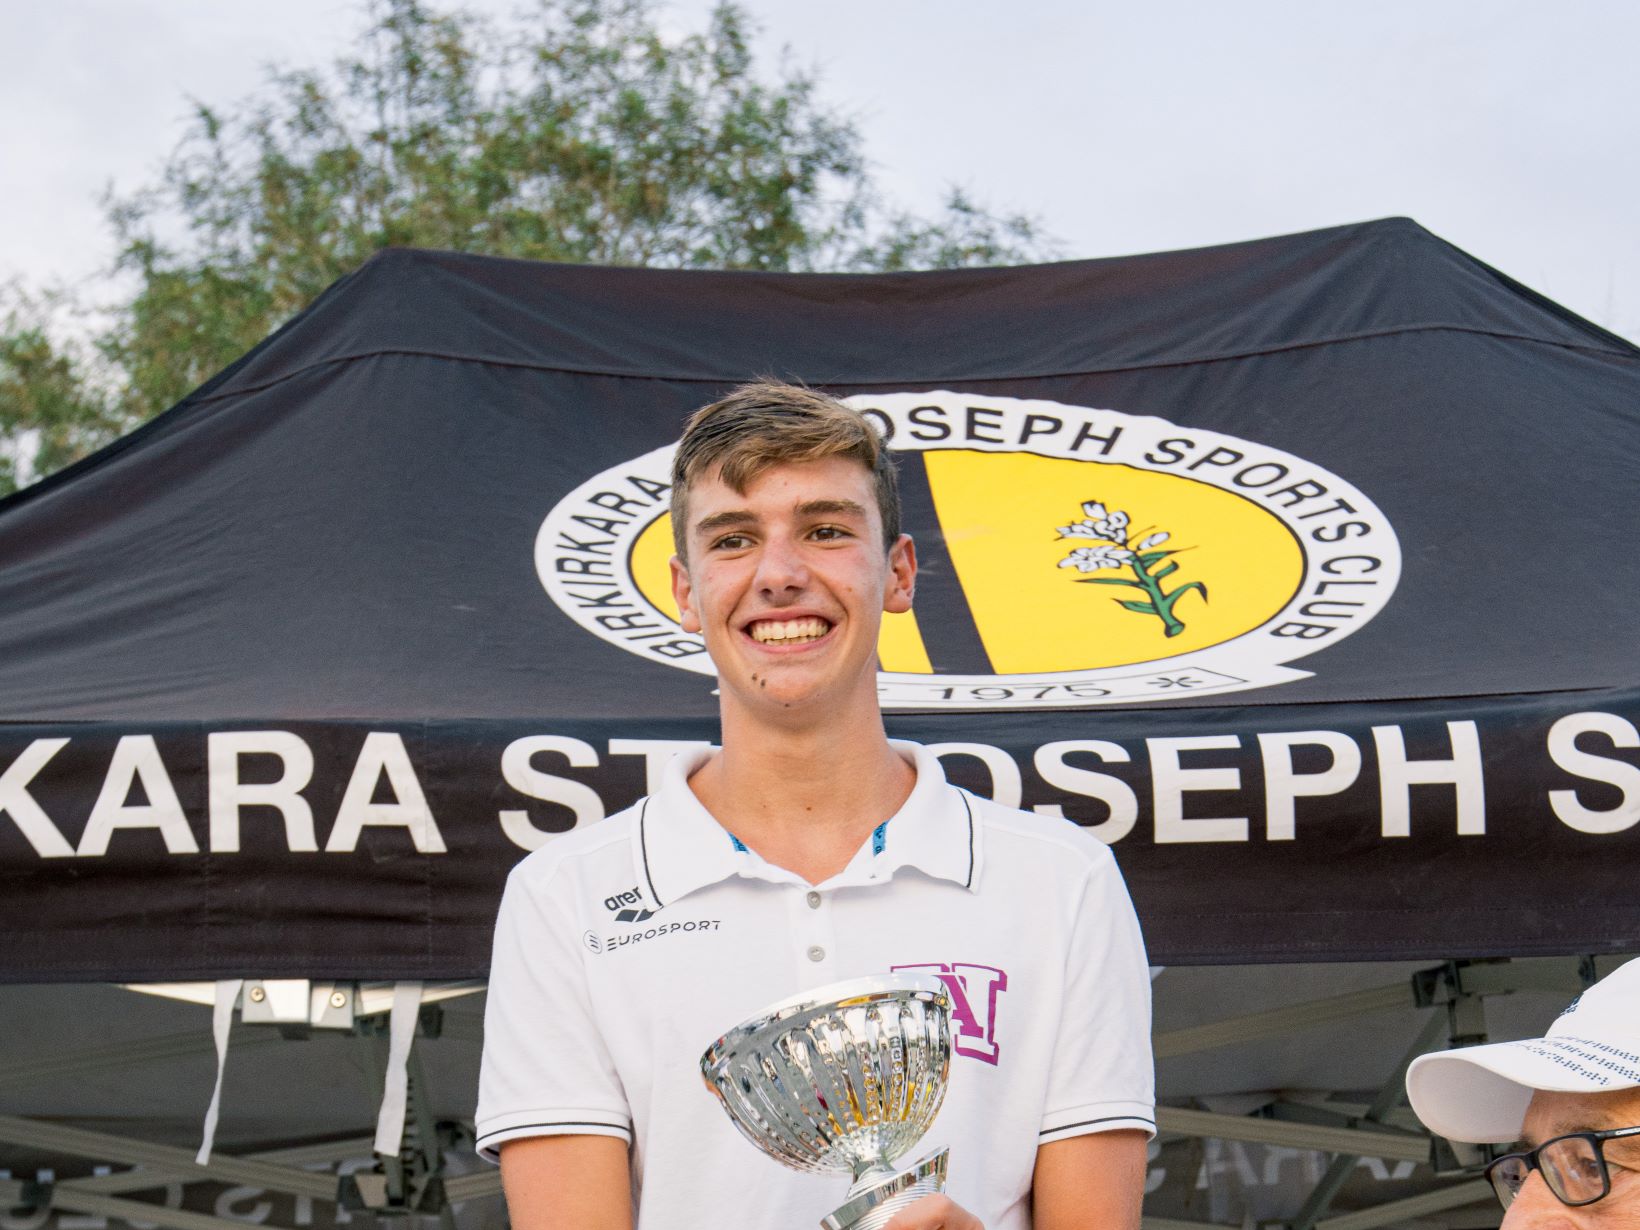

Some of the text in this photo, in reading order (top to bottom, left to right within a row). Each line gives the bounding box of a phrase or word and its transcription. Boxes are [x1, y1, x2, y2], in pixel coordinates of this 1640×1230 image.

[555, 405, 1382, 659] BIRKIRKARA OSEPH SPORTS CLUB
[930, 683, 1112, 700] 1975
[928, 719, 1487, 845] OSEPH
[606, 920, 721, 952] EUROSPORT
